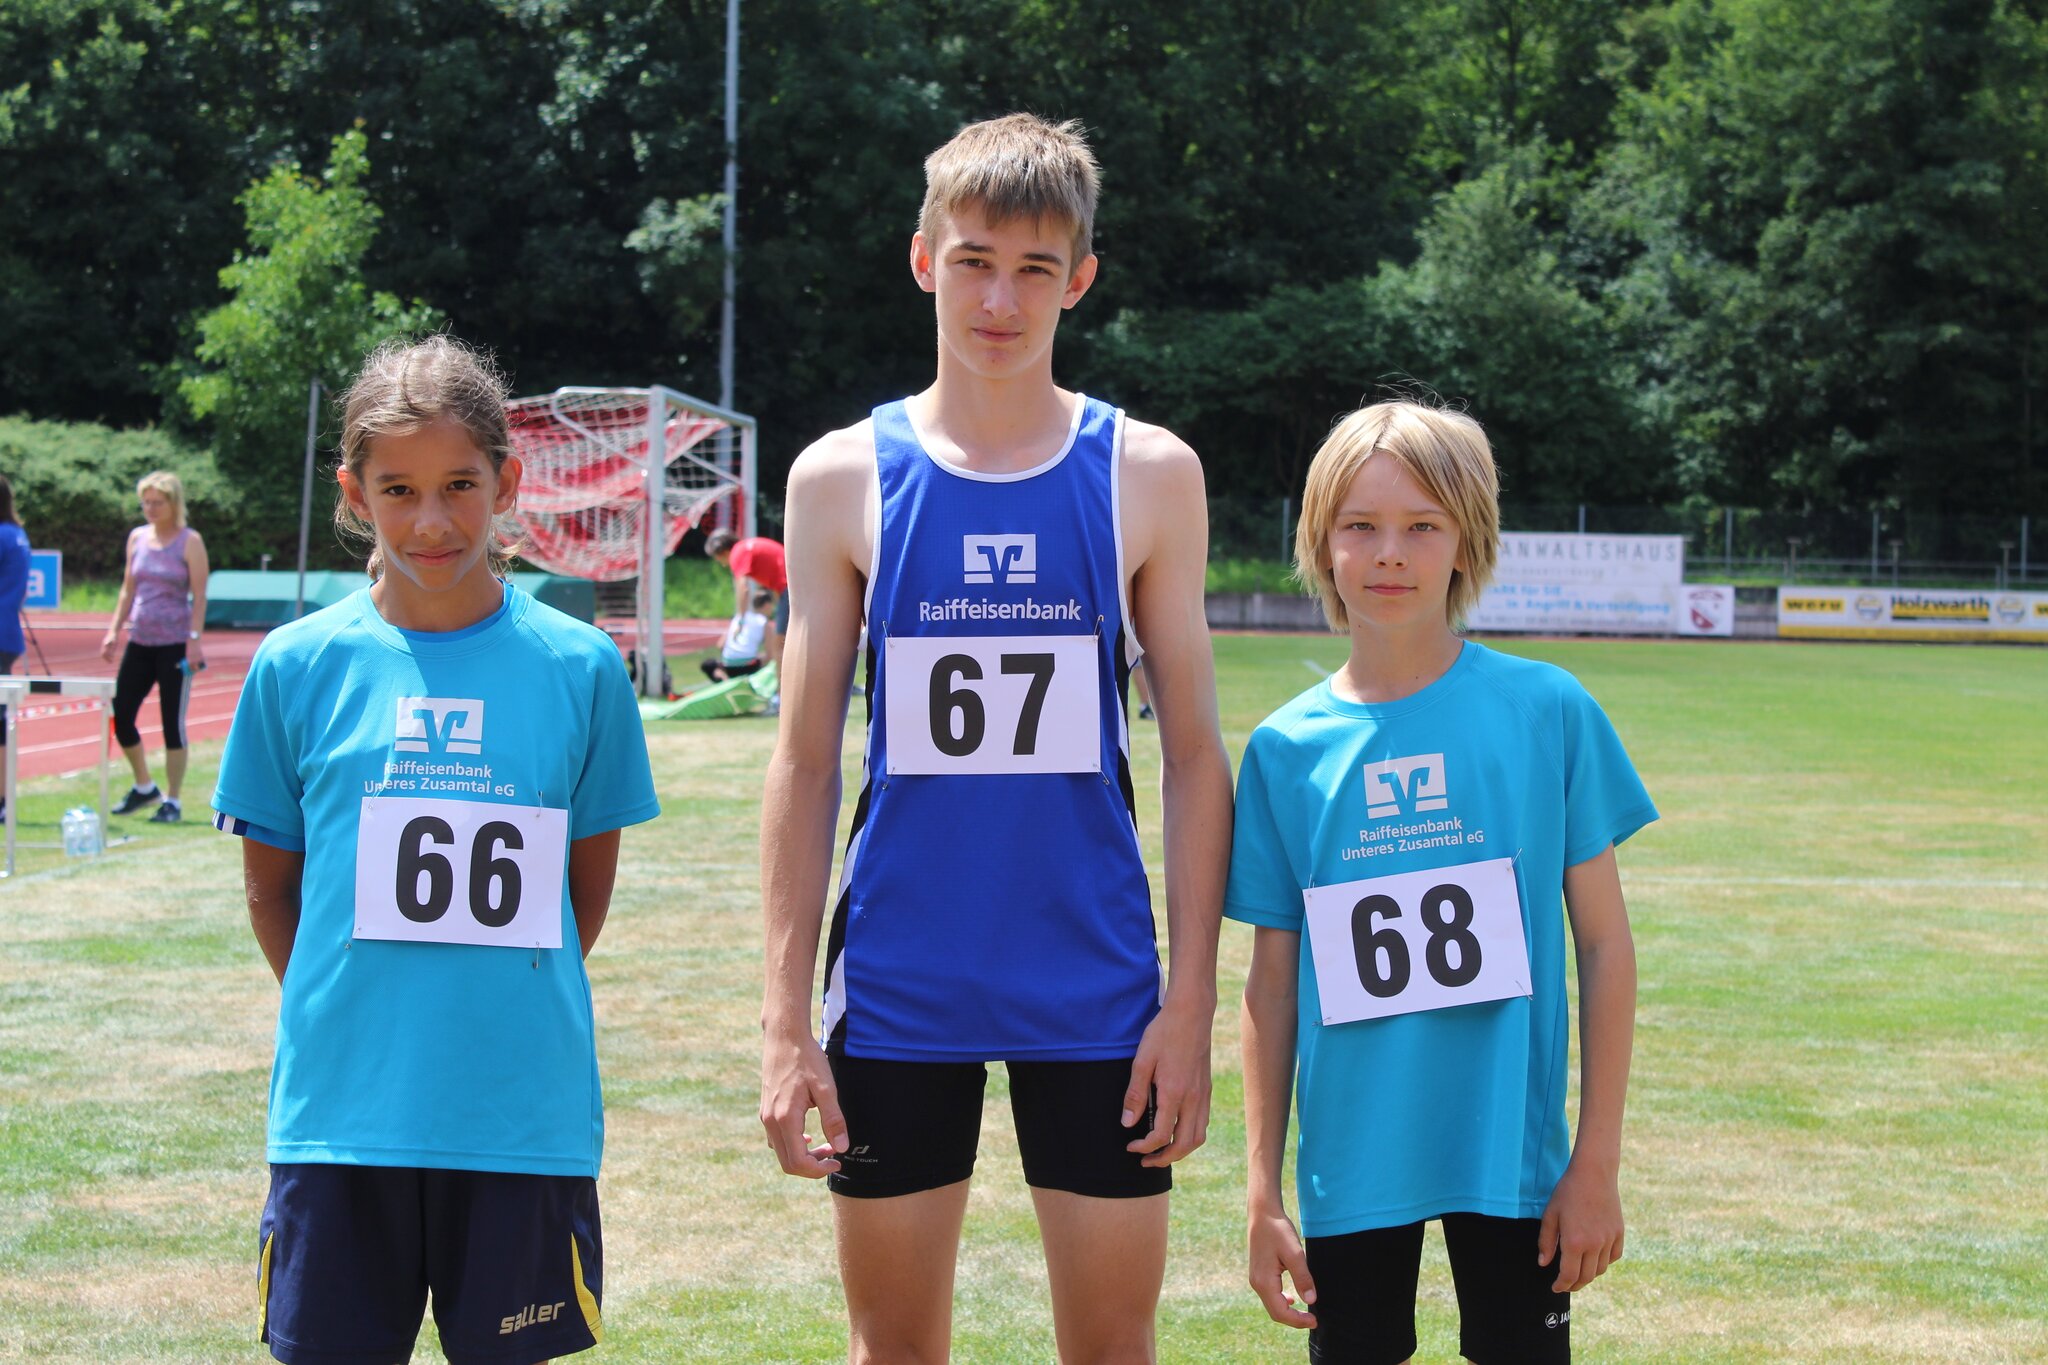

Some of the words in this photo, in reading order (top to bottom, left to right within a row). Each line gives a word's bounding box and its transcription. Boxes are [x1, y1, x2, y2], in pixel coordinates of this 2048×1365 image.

[1500, 541, 1678, 562] ANWALTSHAUS
[920, 598, 1082, 622] Raiffeisenbank
[1892, 594, 1990, 611] Holzwarth
[929, 653, 1056, 757] 67
[384, 761, 493, 778] Raiffeisenbank
[420, 777, 491, 794] Zusamtal
[494, 784, 515, 797] eG
[1359, 816, 1463, 843] Raiffeisenbank
[1341, 841, 1395, 861] Unteres
[1398, 833, 1463, 853] Zusamtal
[1466, 830, 1485, 844] eG
[396, 815, 524, 928] 66
[1351, 883, 1483, 998] 68
[498, 1301, 566, 1335] saller
